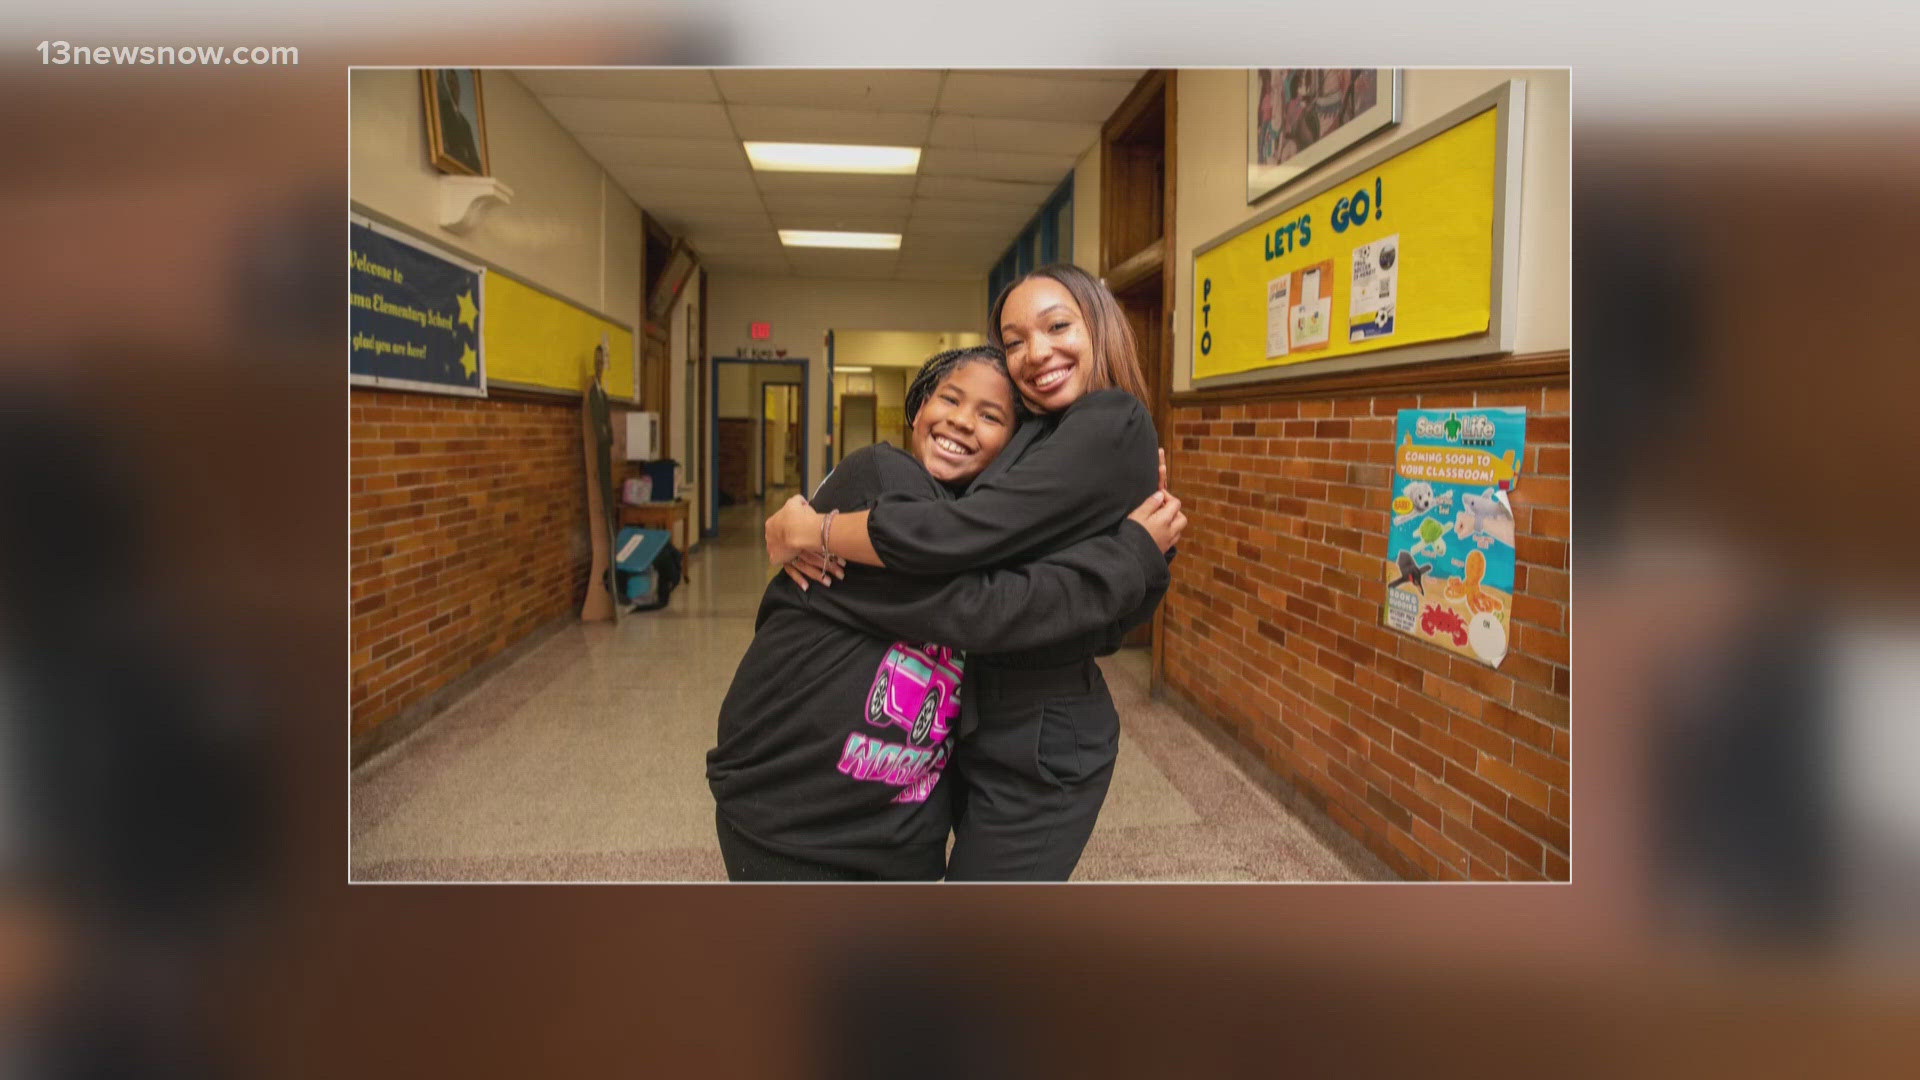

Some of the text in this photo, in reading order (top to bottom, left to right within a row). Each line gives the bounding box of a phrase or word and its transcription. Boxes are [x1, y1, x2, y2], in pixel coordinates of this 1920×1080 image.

[1265, 214, 1311, 261] LET'S
[393, 268, 404, 284] to
[372, 293, 427, 328] Elementary
[428, 309, 453, 331] School
[353, 331, 375, 352] glad
[375, 339, 391, 356] you
[1416, 415, 1496, 439] Sea Life
[1405, 451, 1491, 467] COMING SOON TO
[1401, 465, 1495, 482] YOUR CLASSROOM!
